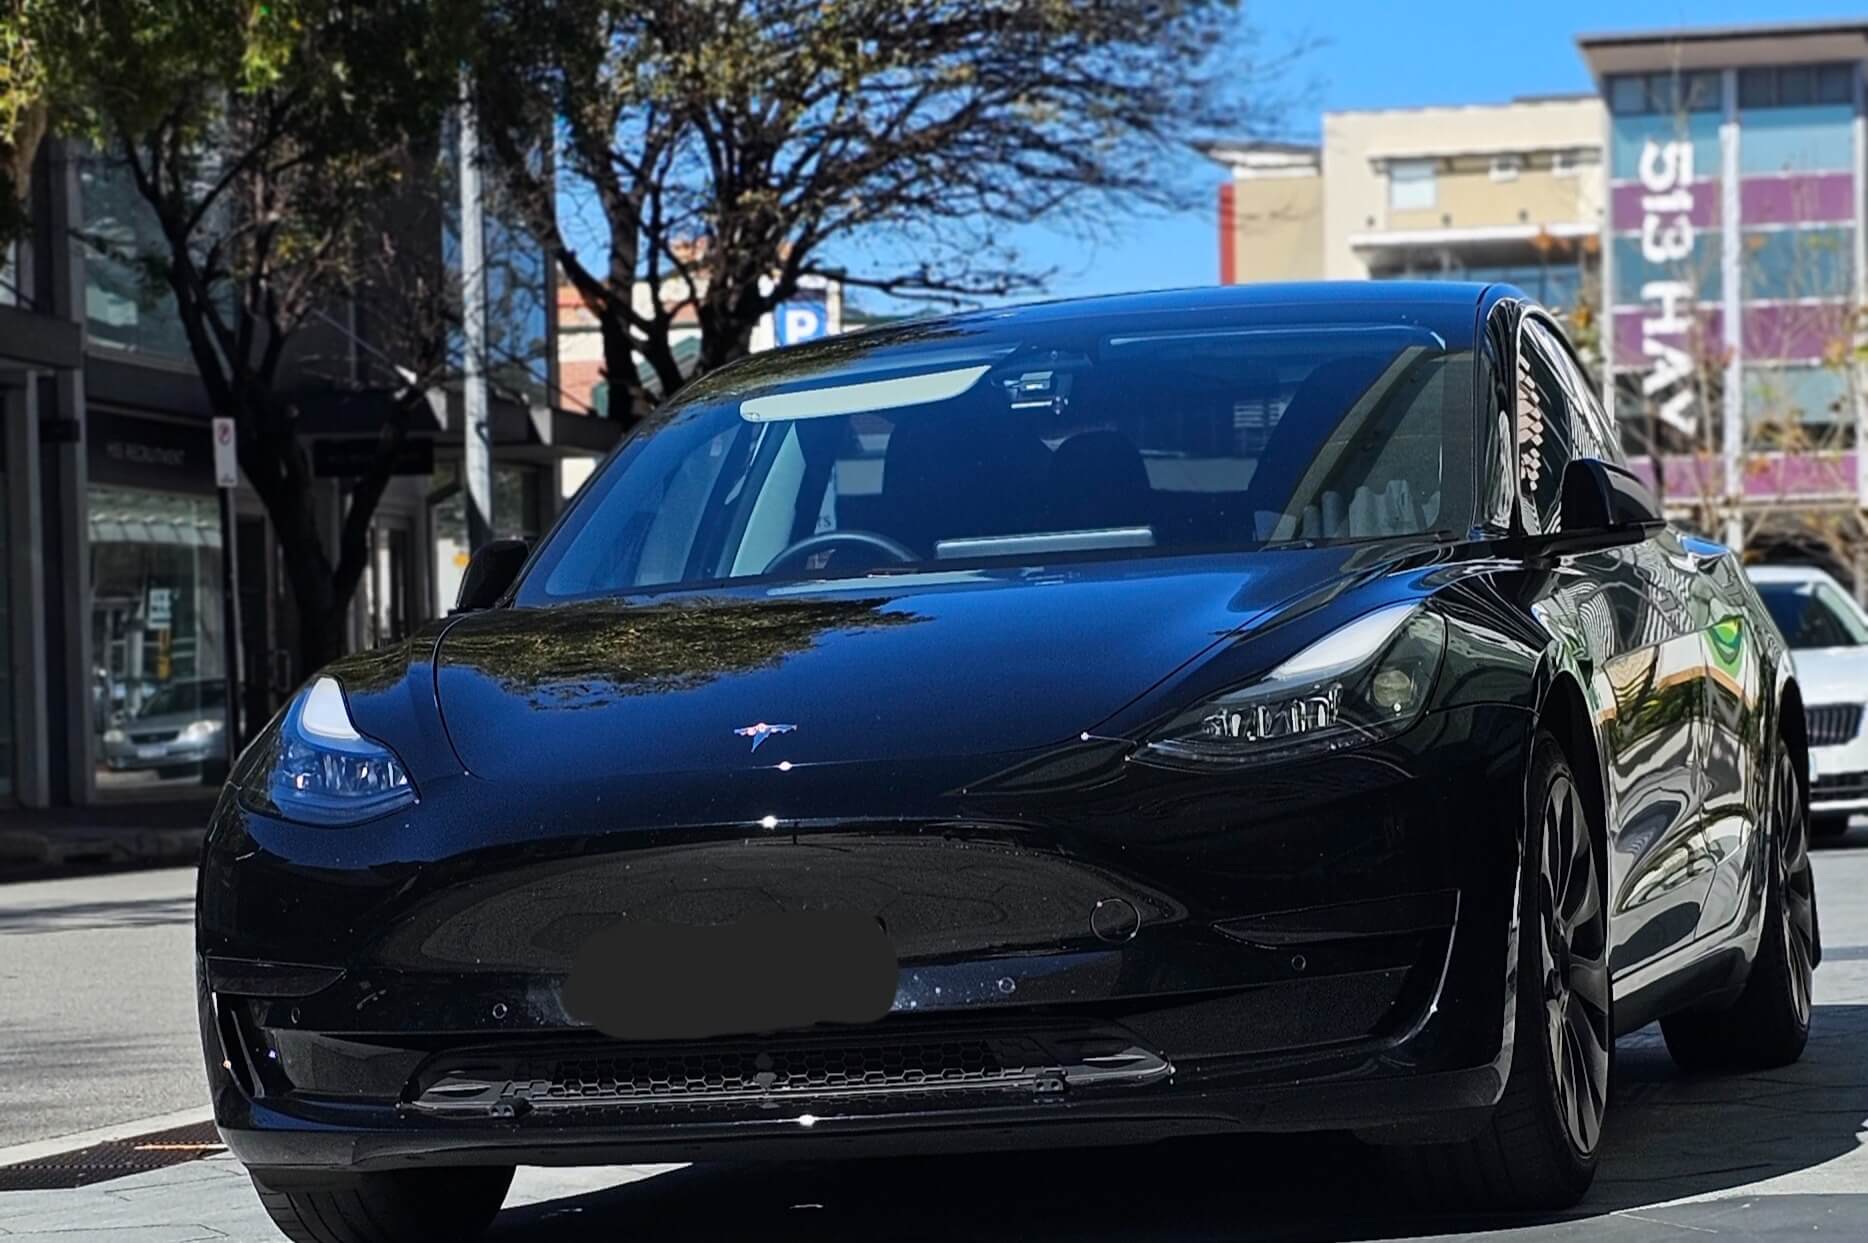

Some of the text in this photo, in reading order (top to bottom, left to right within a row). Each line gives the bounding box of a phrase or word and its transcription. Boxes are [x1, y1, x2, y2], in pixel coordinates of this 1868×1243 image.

[785, 309, 819, 345] P
[1640, 141, 1695, 436] 513 HAY
